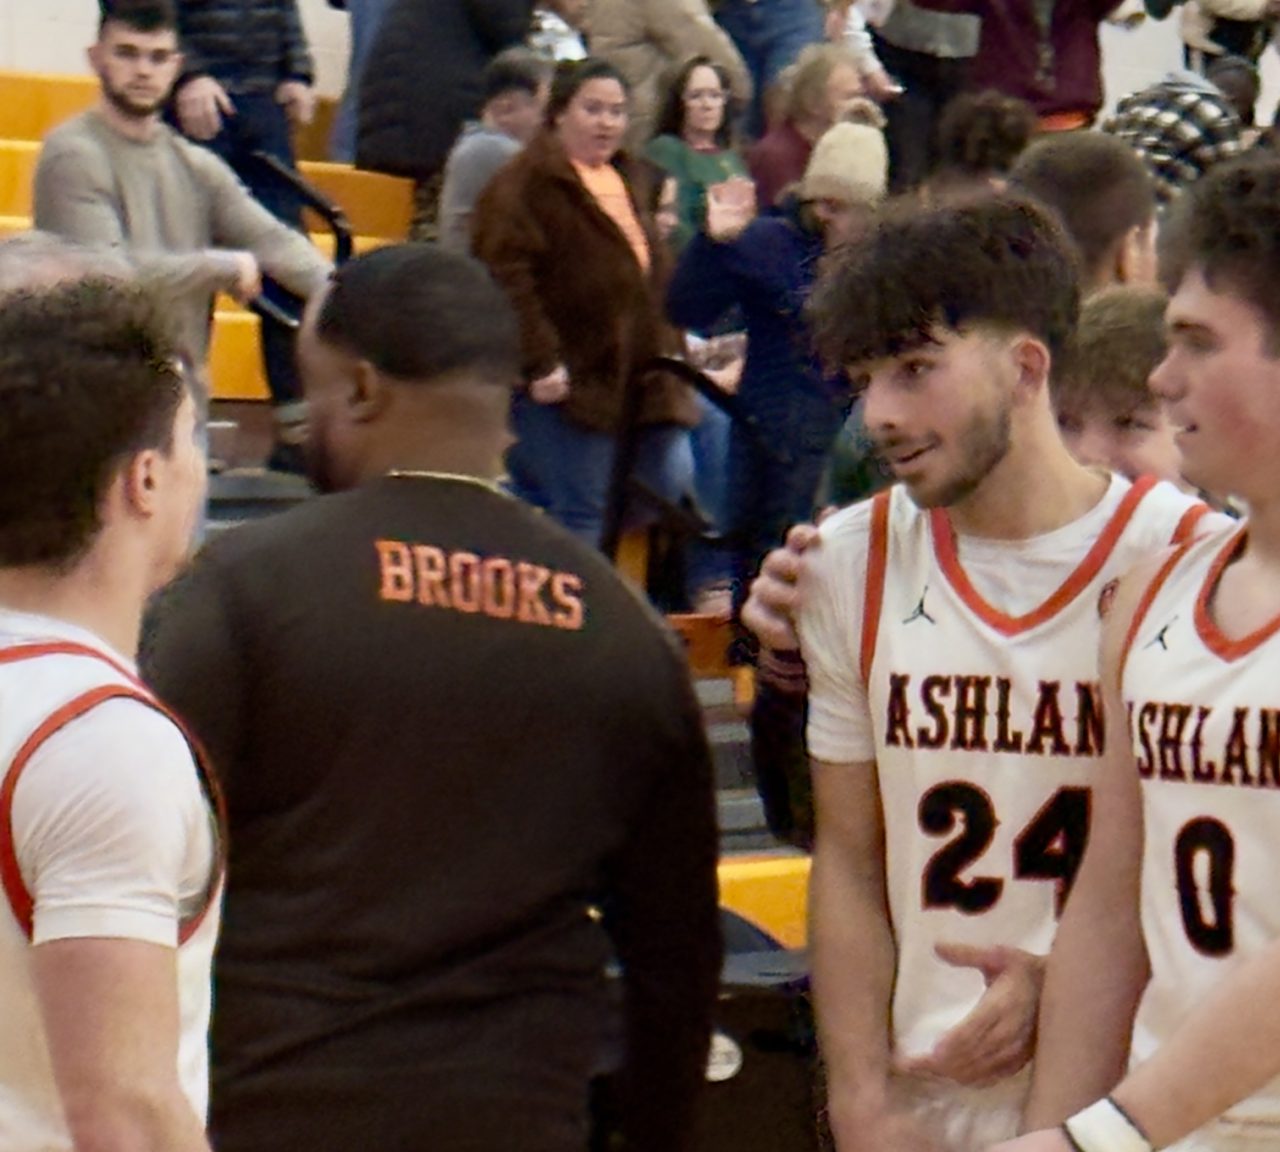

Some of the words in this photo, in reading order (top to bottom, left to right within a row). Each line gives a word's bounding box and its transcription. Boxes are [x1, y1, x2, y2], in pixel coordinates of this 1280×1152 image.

[375, 539, 584, 629] BROOKS
[885, 672, 1106, 756] ASHLAN
[917, 779, 1093, 920] 24
[1174, 815, 1237, 958] 0
